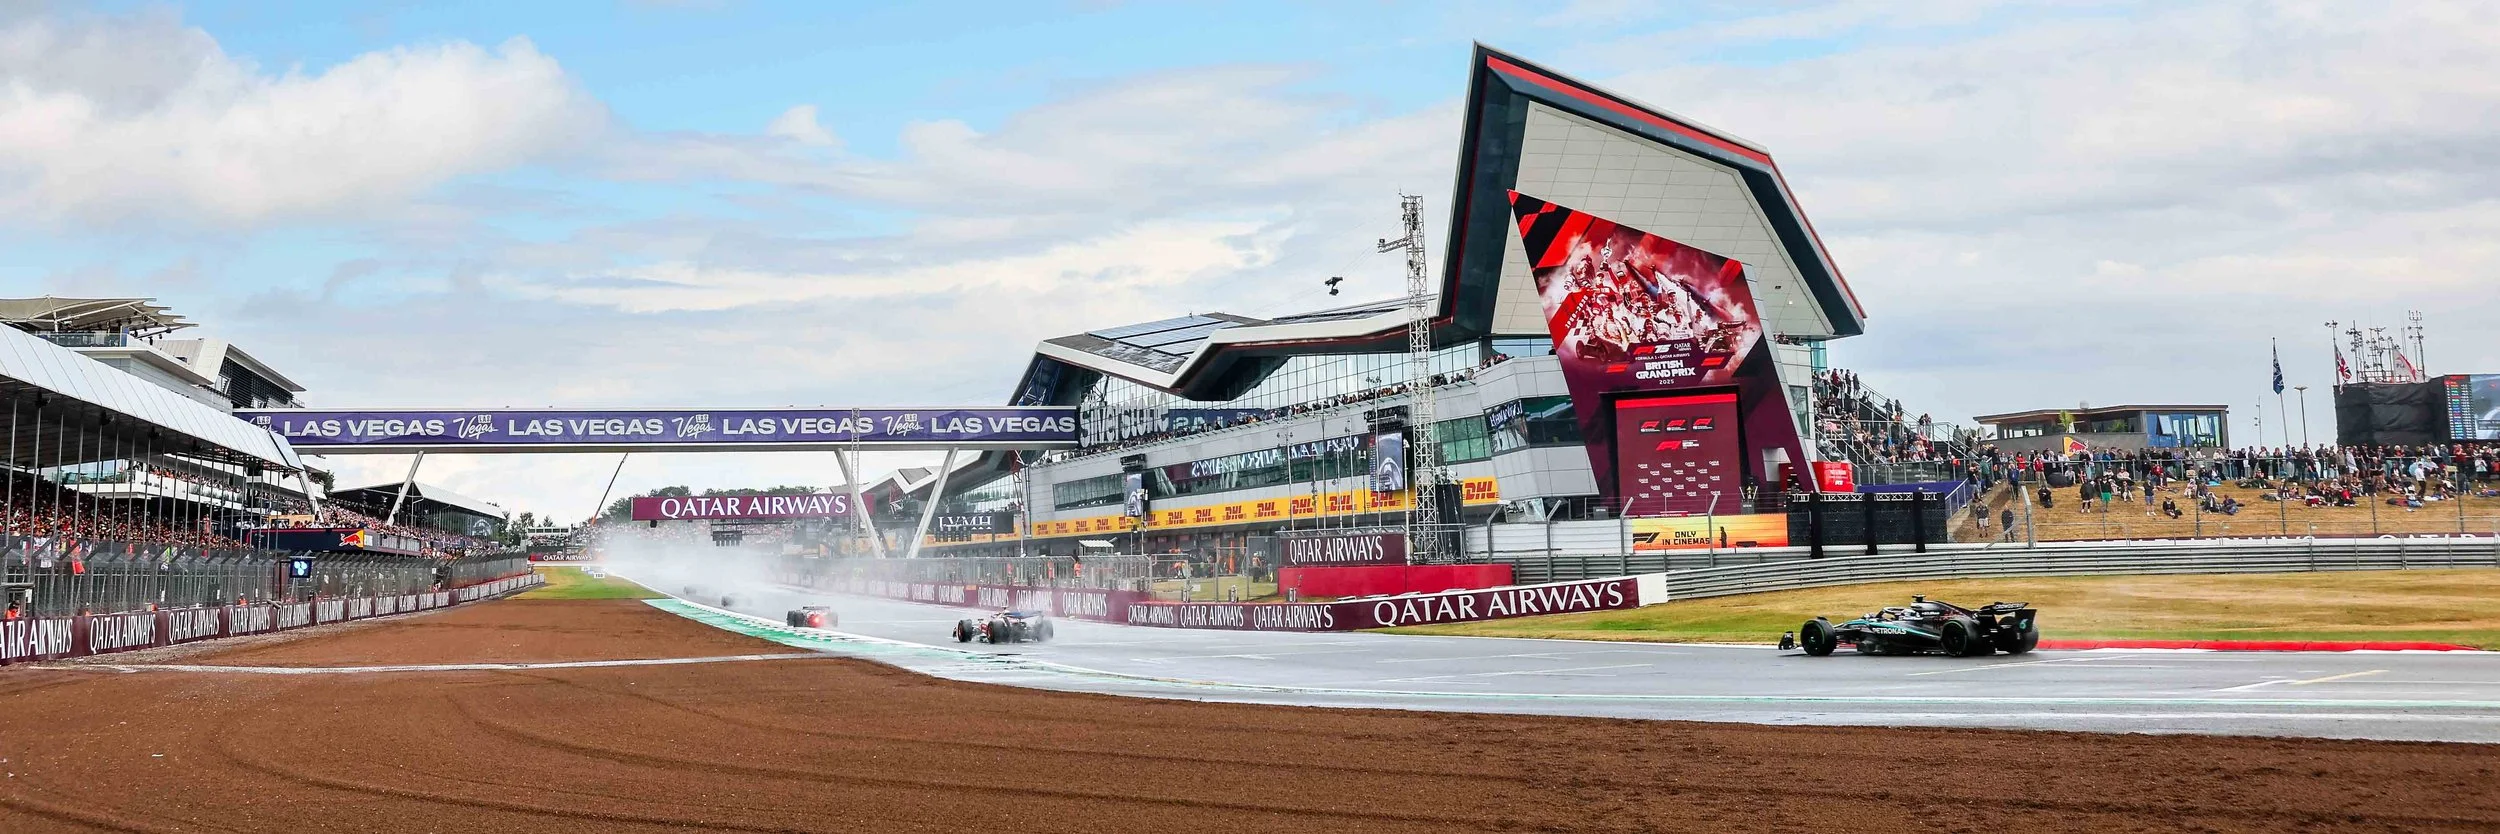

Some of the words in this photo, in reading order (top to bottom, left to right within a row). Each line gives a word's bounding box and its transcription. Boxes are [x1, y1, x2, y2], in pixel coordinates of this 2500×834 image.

[1636, 369, 1670, 379] GRAND
[1672, 367, 1696, 377] PRIX
[1644, 360, 1684, 370] BRITISH
[284, 419, 341, 437] LAS
[346, 419, 445, 437] VEGAS
[453, 416, 499, 439] Vegas
[508, 419, 563, 436] LAS
[568, 418, 664, 436] VEGAS
[672, 416, 716, 439] Vegas
[723, 418, 776, 435] LAS
[781, 417, 875, 435] VEGAS
[882, 415, 924, 436] Vegas
[931, 416, 983, 434] LAS
[987, 416, 1076, 433] VEGAS
[1080, 391, 1169, 447] Silverstone
[1465, 481, 1496, 500] DHL
[660, 498, 741, 518] QATAR
[747, 495, 847, 515] AIRWAYS
[1292, 499, 1313, 514] DHL
[1329, 495, 1353, 511] DHL
[1371, 492, 1397, 508] DHL
[1195, 509, 1212, 522] DHL
[1225, 506, 1244, 520] DHL
[1257, 502, 1277, 517] DHL
[938, 515, 992, 529] LVMH
[1289, 539, 1322, 565] QATAR
[1325, 535, 1384, 562] AIRWAYS
[1673, 537, 1711, 545] CINEMAS
[1063, 592, 1080, 616] QATAR
[1080, 593, 1107, 616] AIRWAYS
[1374, 594, 1479, 627] QATAR
[1487, 581, 1623, 617] AIRWAYS
[228, 606, 248, 636] QATAR
[249, 606, 270, 632] AIRWAYS
[1128, 605, 1147, 623] QATAR
[1148, 606, 1173, 625] AIRWAYS
[1180, 605, 1202, 627] QATAR
[1208, 605, 1244, 627] AIRWAYS
[1253, 605, 1283, 630] QATAR
[1284, 604, 1334, 628] AIRWAYS
[2020, 619, 2028, 629] 6
[90, 616, 121, 654] QATAR
[121, 613, 156, 649] AIRWAYS
[169, 609, 192, 645] QATAR
[193, 608, 220, 639] AIRWAYS
[1872, 627, 1906, 635] PETRONAS
[28, 618, 73, 656] AIRWAYS
